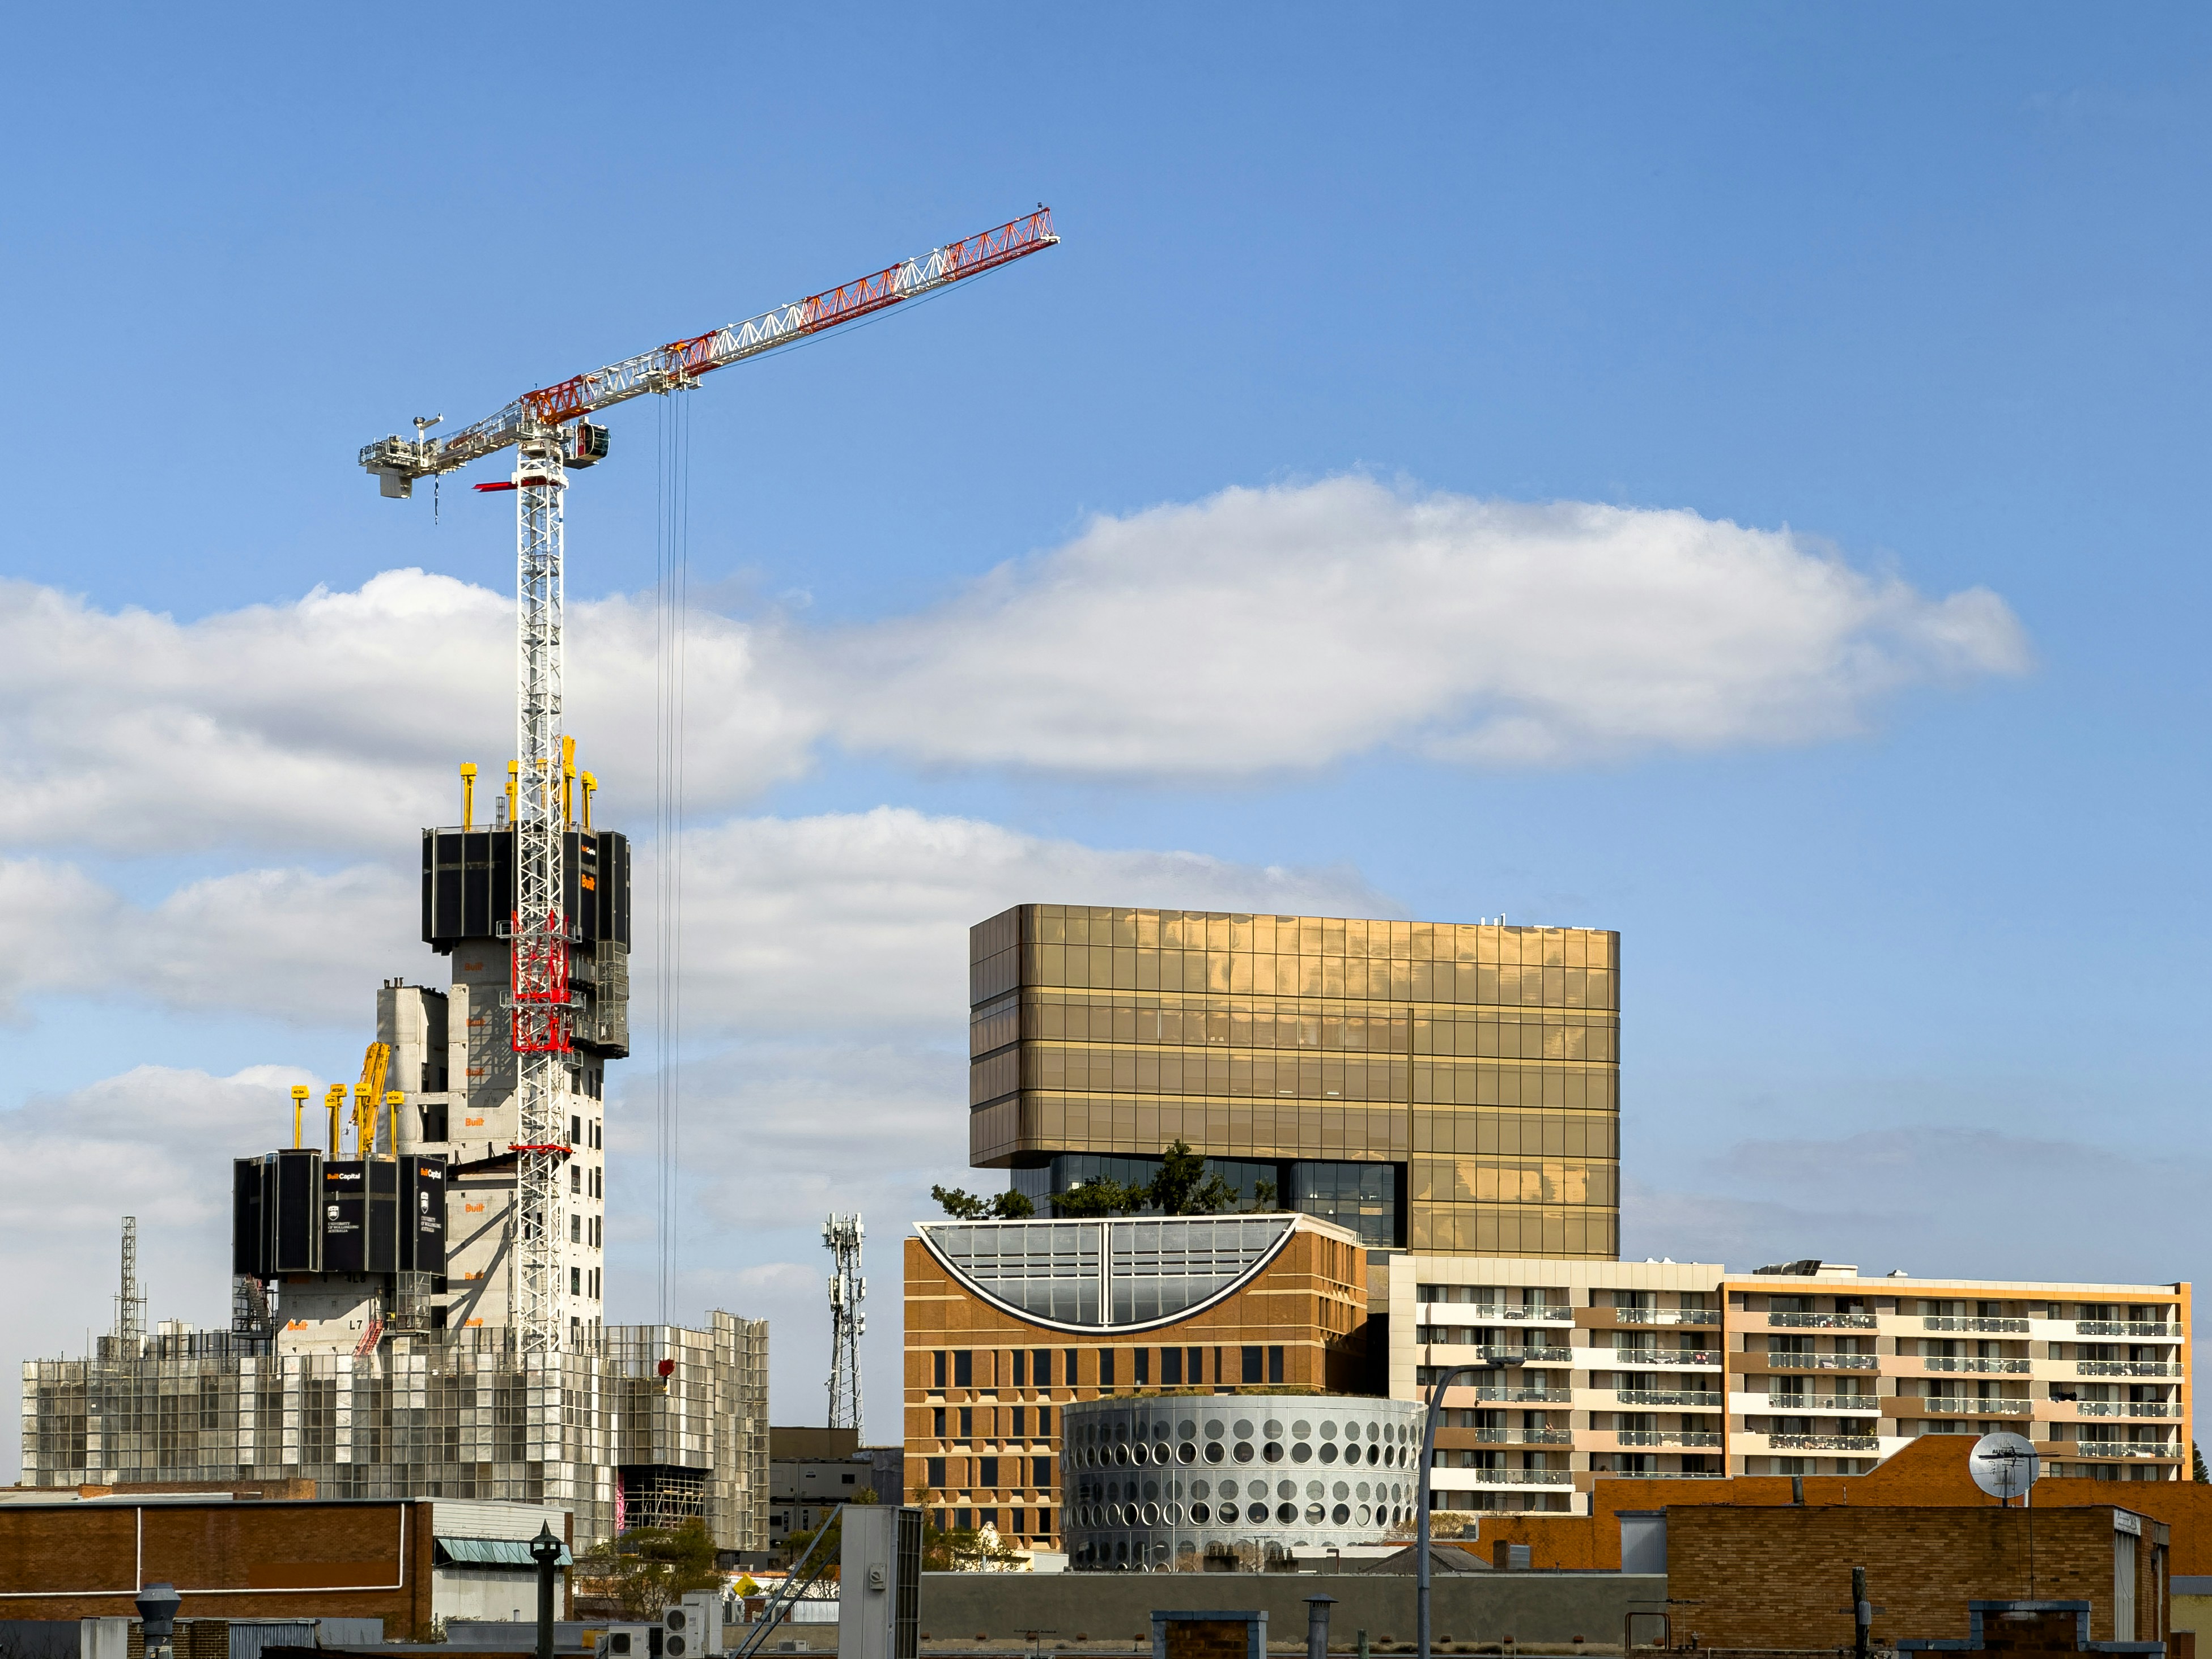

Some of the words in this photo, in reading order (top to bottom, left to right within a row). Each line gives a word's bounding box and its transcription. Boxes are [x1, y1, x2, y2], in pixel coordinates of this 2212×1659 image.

[582, 874, 595, 891] Built
[465, 1117, 485, 1126] Built
[465, 1203, 485, 1213] Built
[287, 1320, 308, 1331] Built
[349, 1320, 363, 1330] L7
